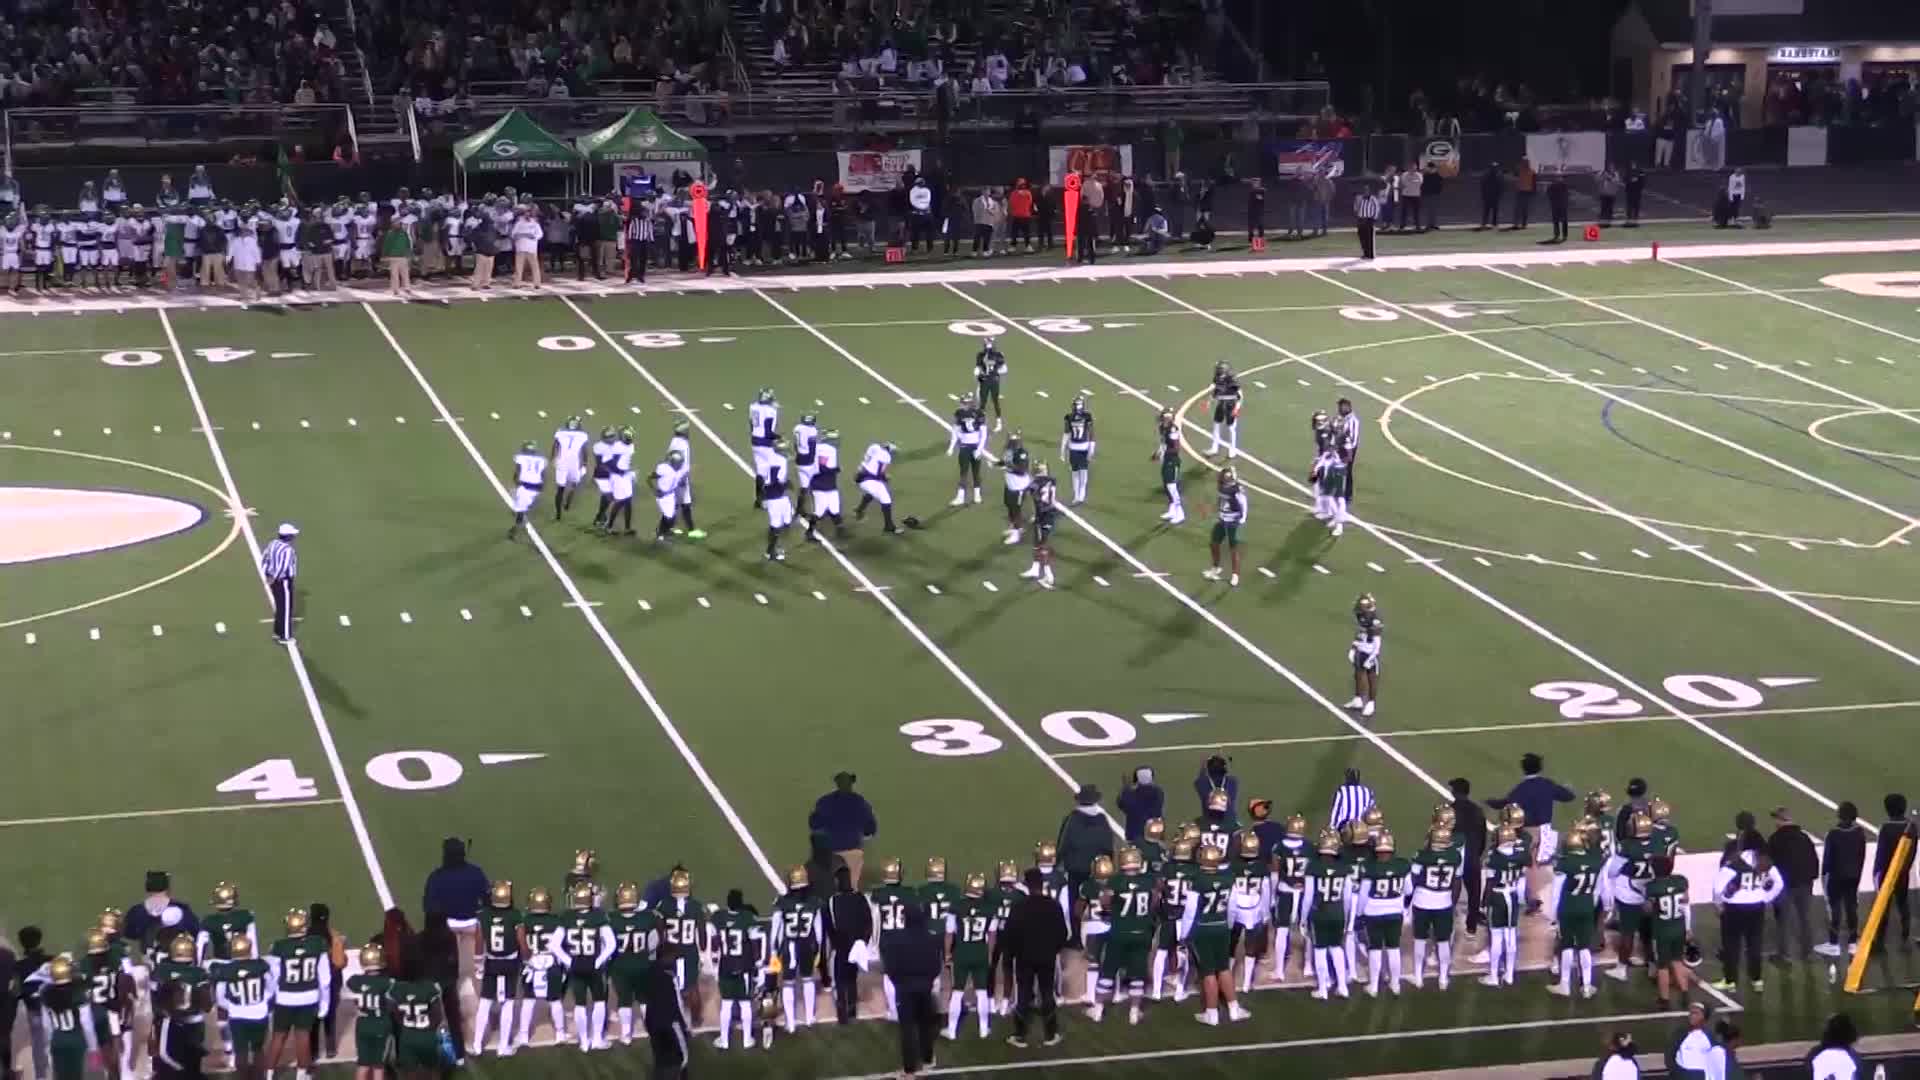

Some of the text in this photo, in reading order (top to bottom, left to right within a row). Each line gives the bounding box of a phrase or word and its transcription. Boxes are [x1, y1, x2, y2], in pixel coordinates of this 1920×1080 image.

[1529, 675, 1764, 719] 20
[899, 711, 1137, 756] 30
[215, 751, 464, 800] 40
[1317, 877, 1345, 902] 49
[1119, 892, 1150, 917] 78
[666, 918, 696, 945] 20
[784, 911, 814, 938] 23
[962, 916, 987, 942] 19
[490, 925, 505, 952] 6
[567, 928, 596, 956] 56
[285, 957, 318, 985] 60
[229, 977, 262, 1007] 40
